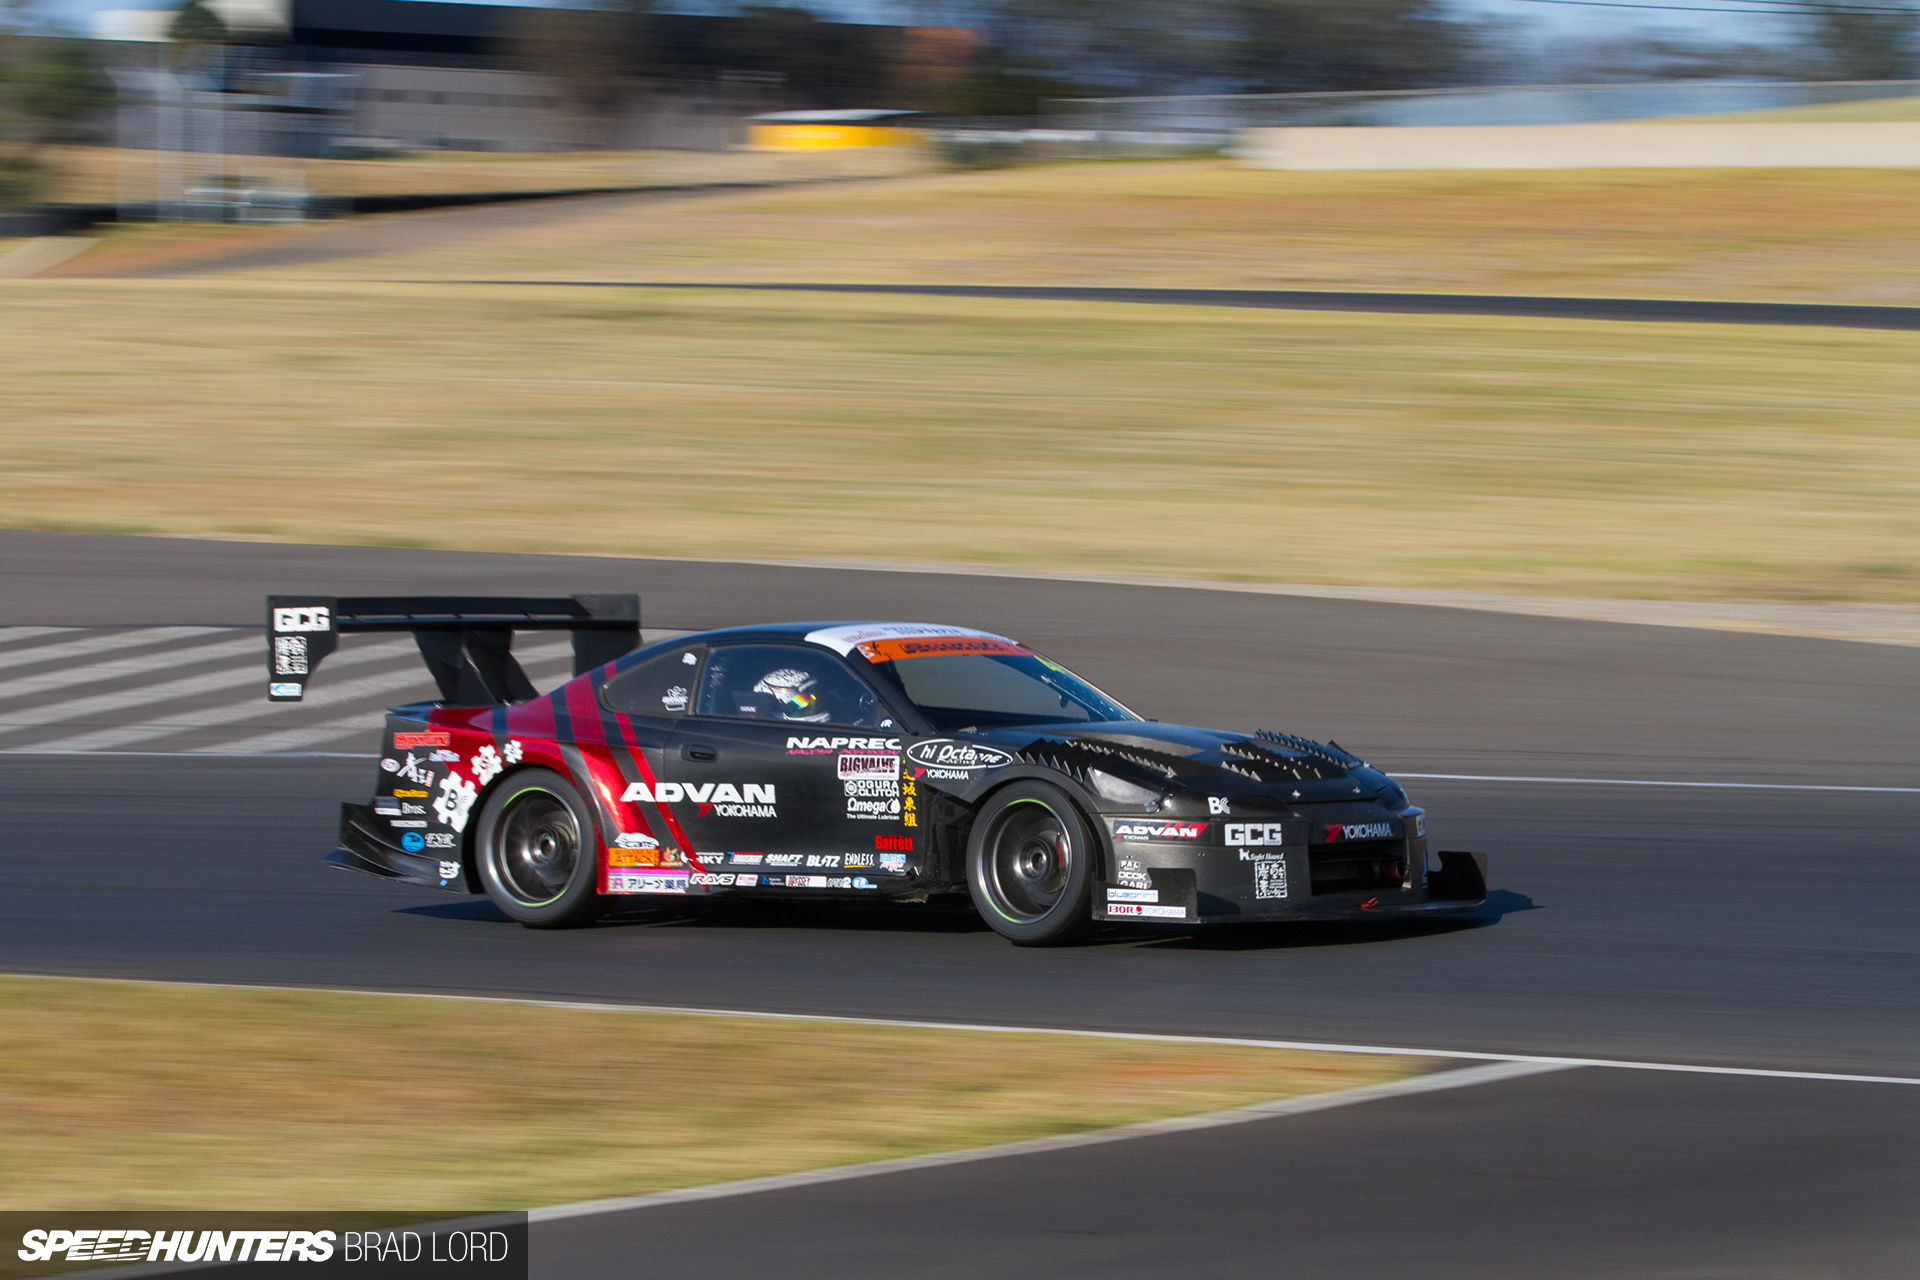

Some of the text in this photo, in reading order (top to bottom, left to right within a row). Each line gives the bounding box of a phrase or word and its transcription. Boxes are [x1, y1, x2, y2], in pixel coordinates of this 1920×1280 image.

[273, 606, 330, 632] GCG
[786, 737, 902, 750] NAPREC
[920, 744, 938, 759] hi
[926, 769, 969, 780] YOKOHAMA
[858, 780, 900, 789] OGURA
[620, 782, 777, 804] ADVAN
[858, 788, 900, 797] CLUTCH
[714, 804, 778, 818] YOKOHAMA
[1115, 825, 1198, 837] ADVAN
[1224, 823, 1282, 846] GCG
[1342, 823, 1393, 840] YOKOHAMA
[875, 835, 914, 851] Garrett
[806, 854, 841, 868] BLITZ
[844, 852, 875, 866] ENDLESS
[689, 873, 736, 886] RAYS
[1118, 871, 1147, 881] DECK
[1108, 890, 1157, 900] blueprint
[1143, 907, 1185, 915] YOKOHAMA
